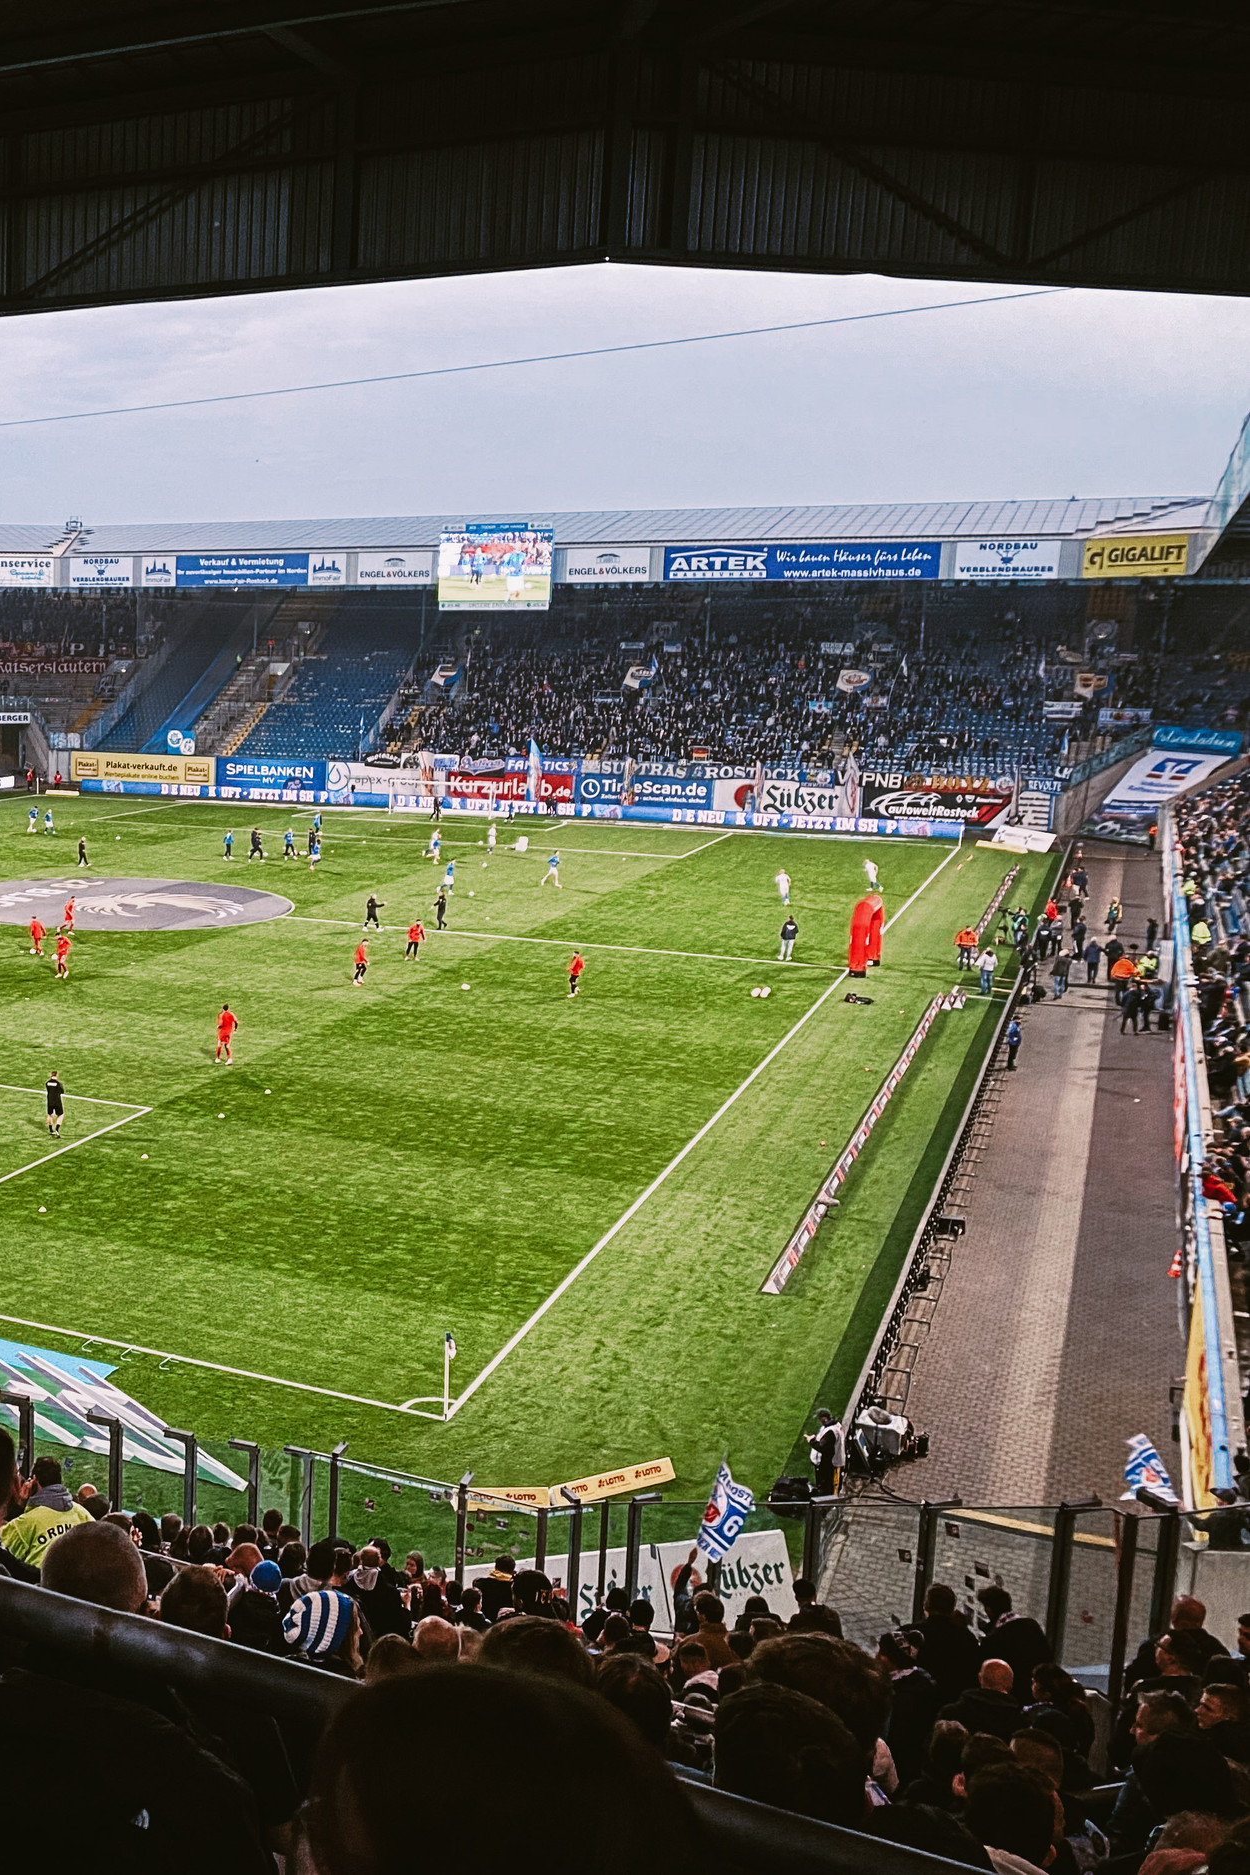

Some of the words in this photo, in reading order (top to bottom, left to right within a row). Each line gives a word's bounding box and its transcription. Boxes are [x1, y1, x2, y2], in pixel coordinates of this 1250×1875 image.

[979, 542, 1038, 550] NORDBAU
[776, 550, 796, 563] Wir
[799, 550, 830, 563] bauen
[833, 548, 872, 563] Häuser
[874, 549, 898, 568] fürs
[900, 548, 932, 561] Leben
[1108, 545, 1187, 563] GIGALIFT
[199, 558, 230, 566] Verkauf
[230, 558, 237, 566] &
[239, 558, 284, 567] Vermietung
[670, 556, 767, 570] ARTEK
[960, 565, 1054, 573] VERBLENDMAURER
[784, 568, 922, 579] www.artek-massivhaus.de
[106, 761, 178, 772] Plakat-verkauft.de
[226, 763, 314, 779] SPIELBANKEN
[507, 759, 570, 772] FANTICS
[601, 760, 688, 778] SUTRAS
[450, 776, 571, 798] Kurzurlab.de
[1028, 780, 1062, 791] REVOLTE
[248, 788, 281, 800] JETZT
[762, 784, 840, 815] Lübzer
[888, 804, 980, 818] autoweltRostock
[790, 814, 833, 830] JETZT
[836, 817, 856, 832] IM
[641, 1466, 662, 1477] LOTTO
[605, 1474, 626, 1487] LOTTO
[570, 1484, 588, 1494] OTTO
[513, 1493, 536, 1501] LOTTO
